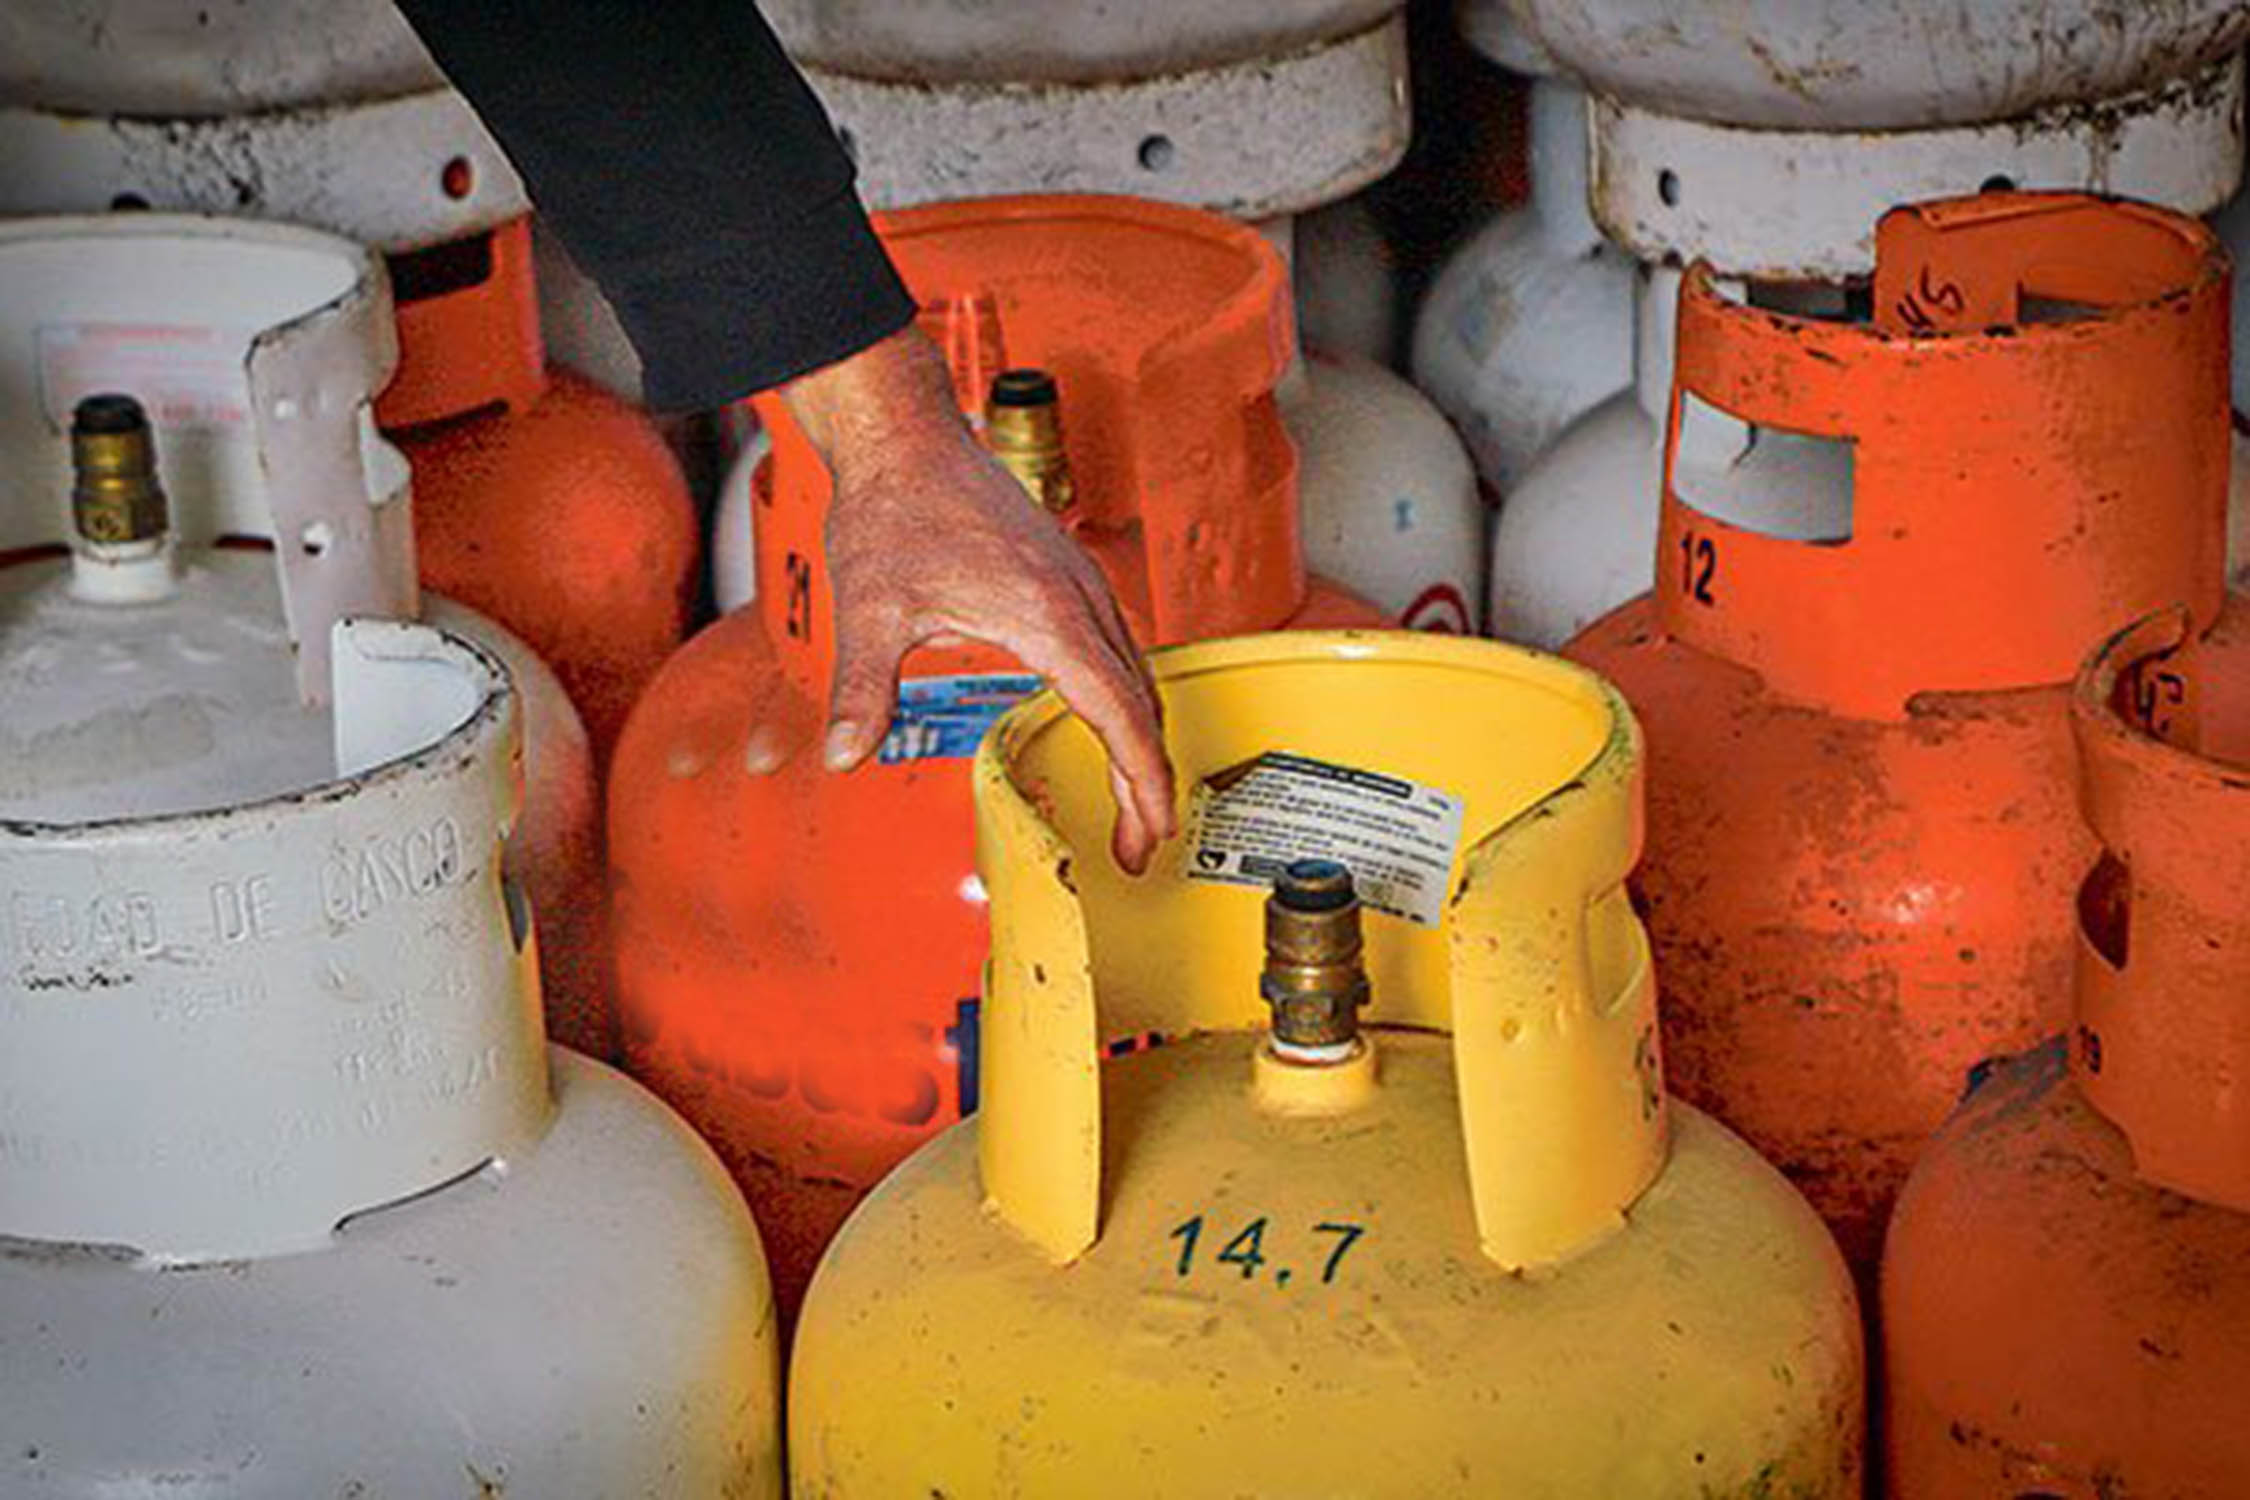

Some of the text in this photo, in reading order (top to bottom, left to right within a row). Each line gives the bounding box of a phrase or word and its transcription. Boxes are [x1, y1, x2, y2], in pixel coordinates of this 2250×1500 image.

[1681, 531, 1716, 607] 12
[210, 872, 278, 943] DE
[1169, 1214, 1365, 1290] 14.7
